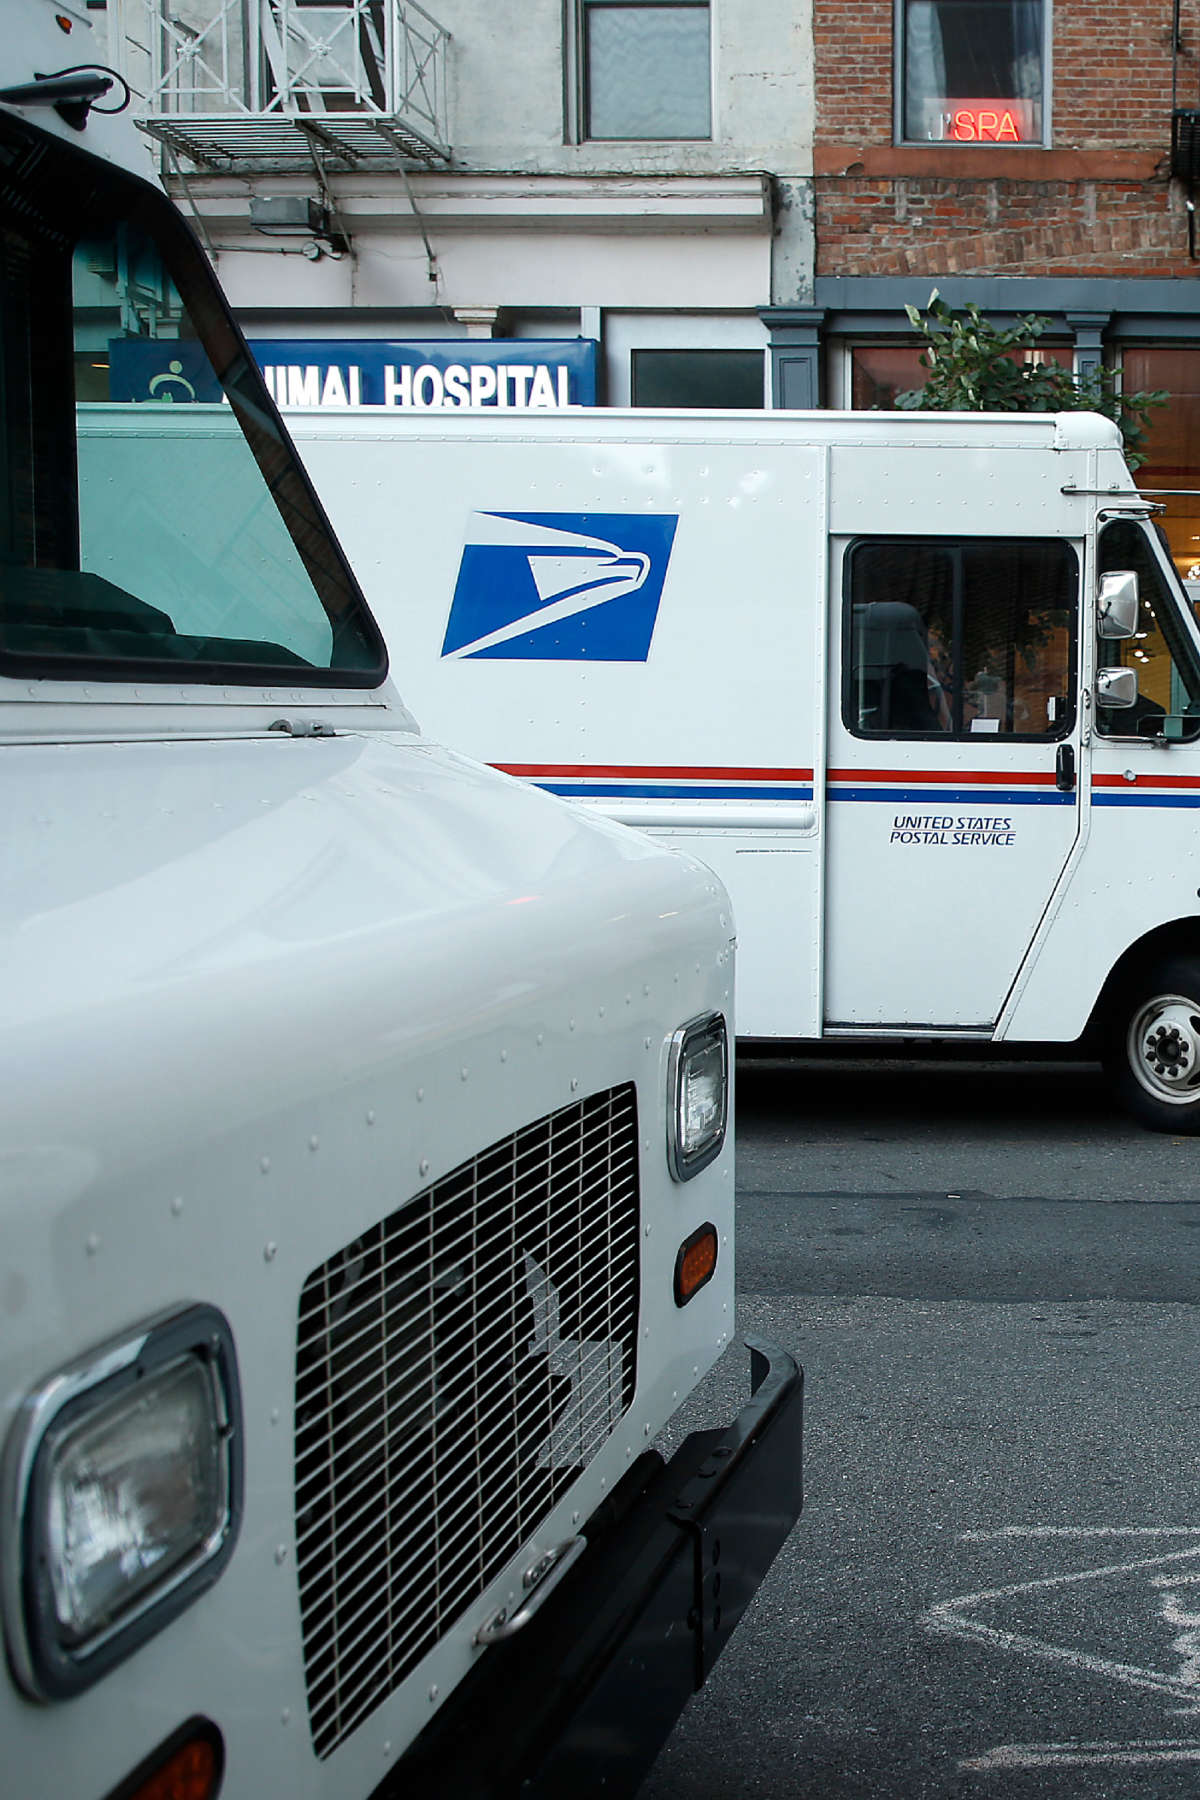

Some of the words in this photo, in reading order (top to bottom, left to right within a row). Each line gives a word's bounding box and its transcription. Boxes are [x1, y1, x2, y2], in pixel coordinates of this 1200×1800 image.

[384, 364, 582, 408] HOSPITAL
[893, 815, 954, 830] UNITED
[955, 816, 1012, 831] STATES
[889, 831, 949, 845] POSTAL
[951, 832, 1017, 846] SERVICE
